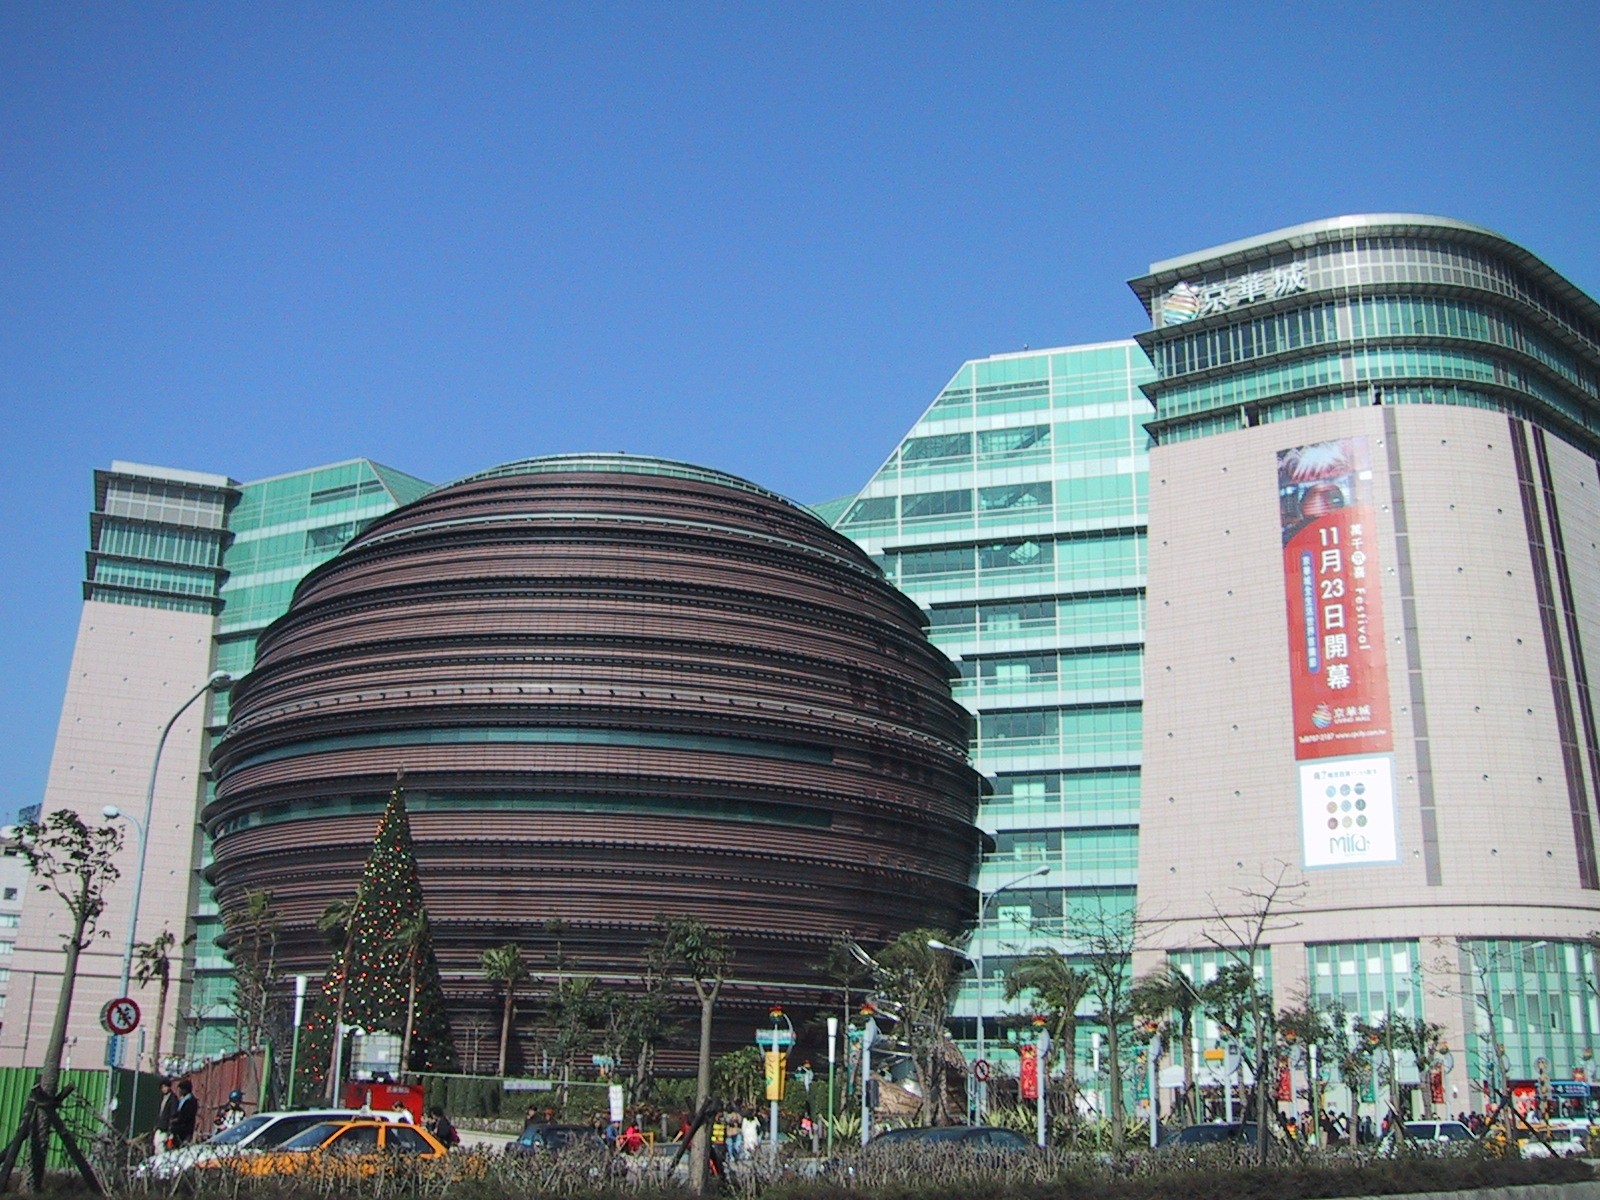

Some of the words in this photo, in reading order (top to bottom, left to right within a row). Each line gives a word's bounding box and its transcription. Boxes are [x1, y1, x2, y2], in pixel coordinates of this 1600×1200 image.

[1200, 262, 1305, 315] 京華城
[1319, 527, 1351, 690] 11月23日開幕
[1355, 588, 1370, 650] Festival
